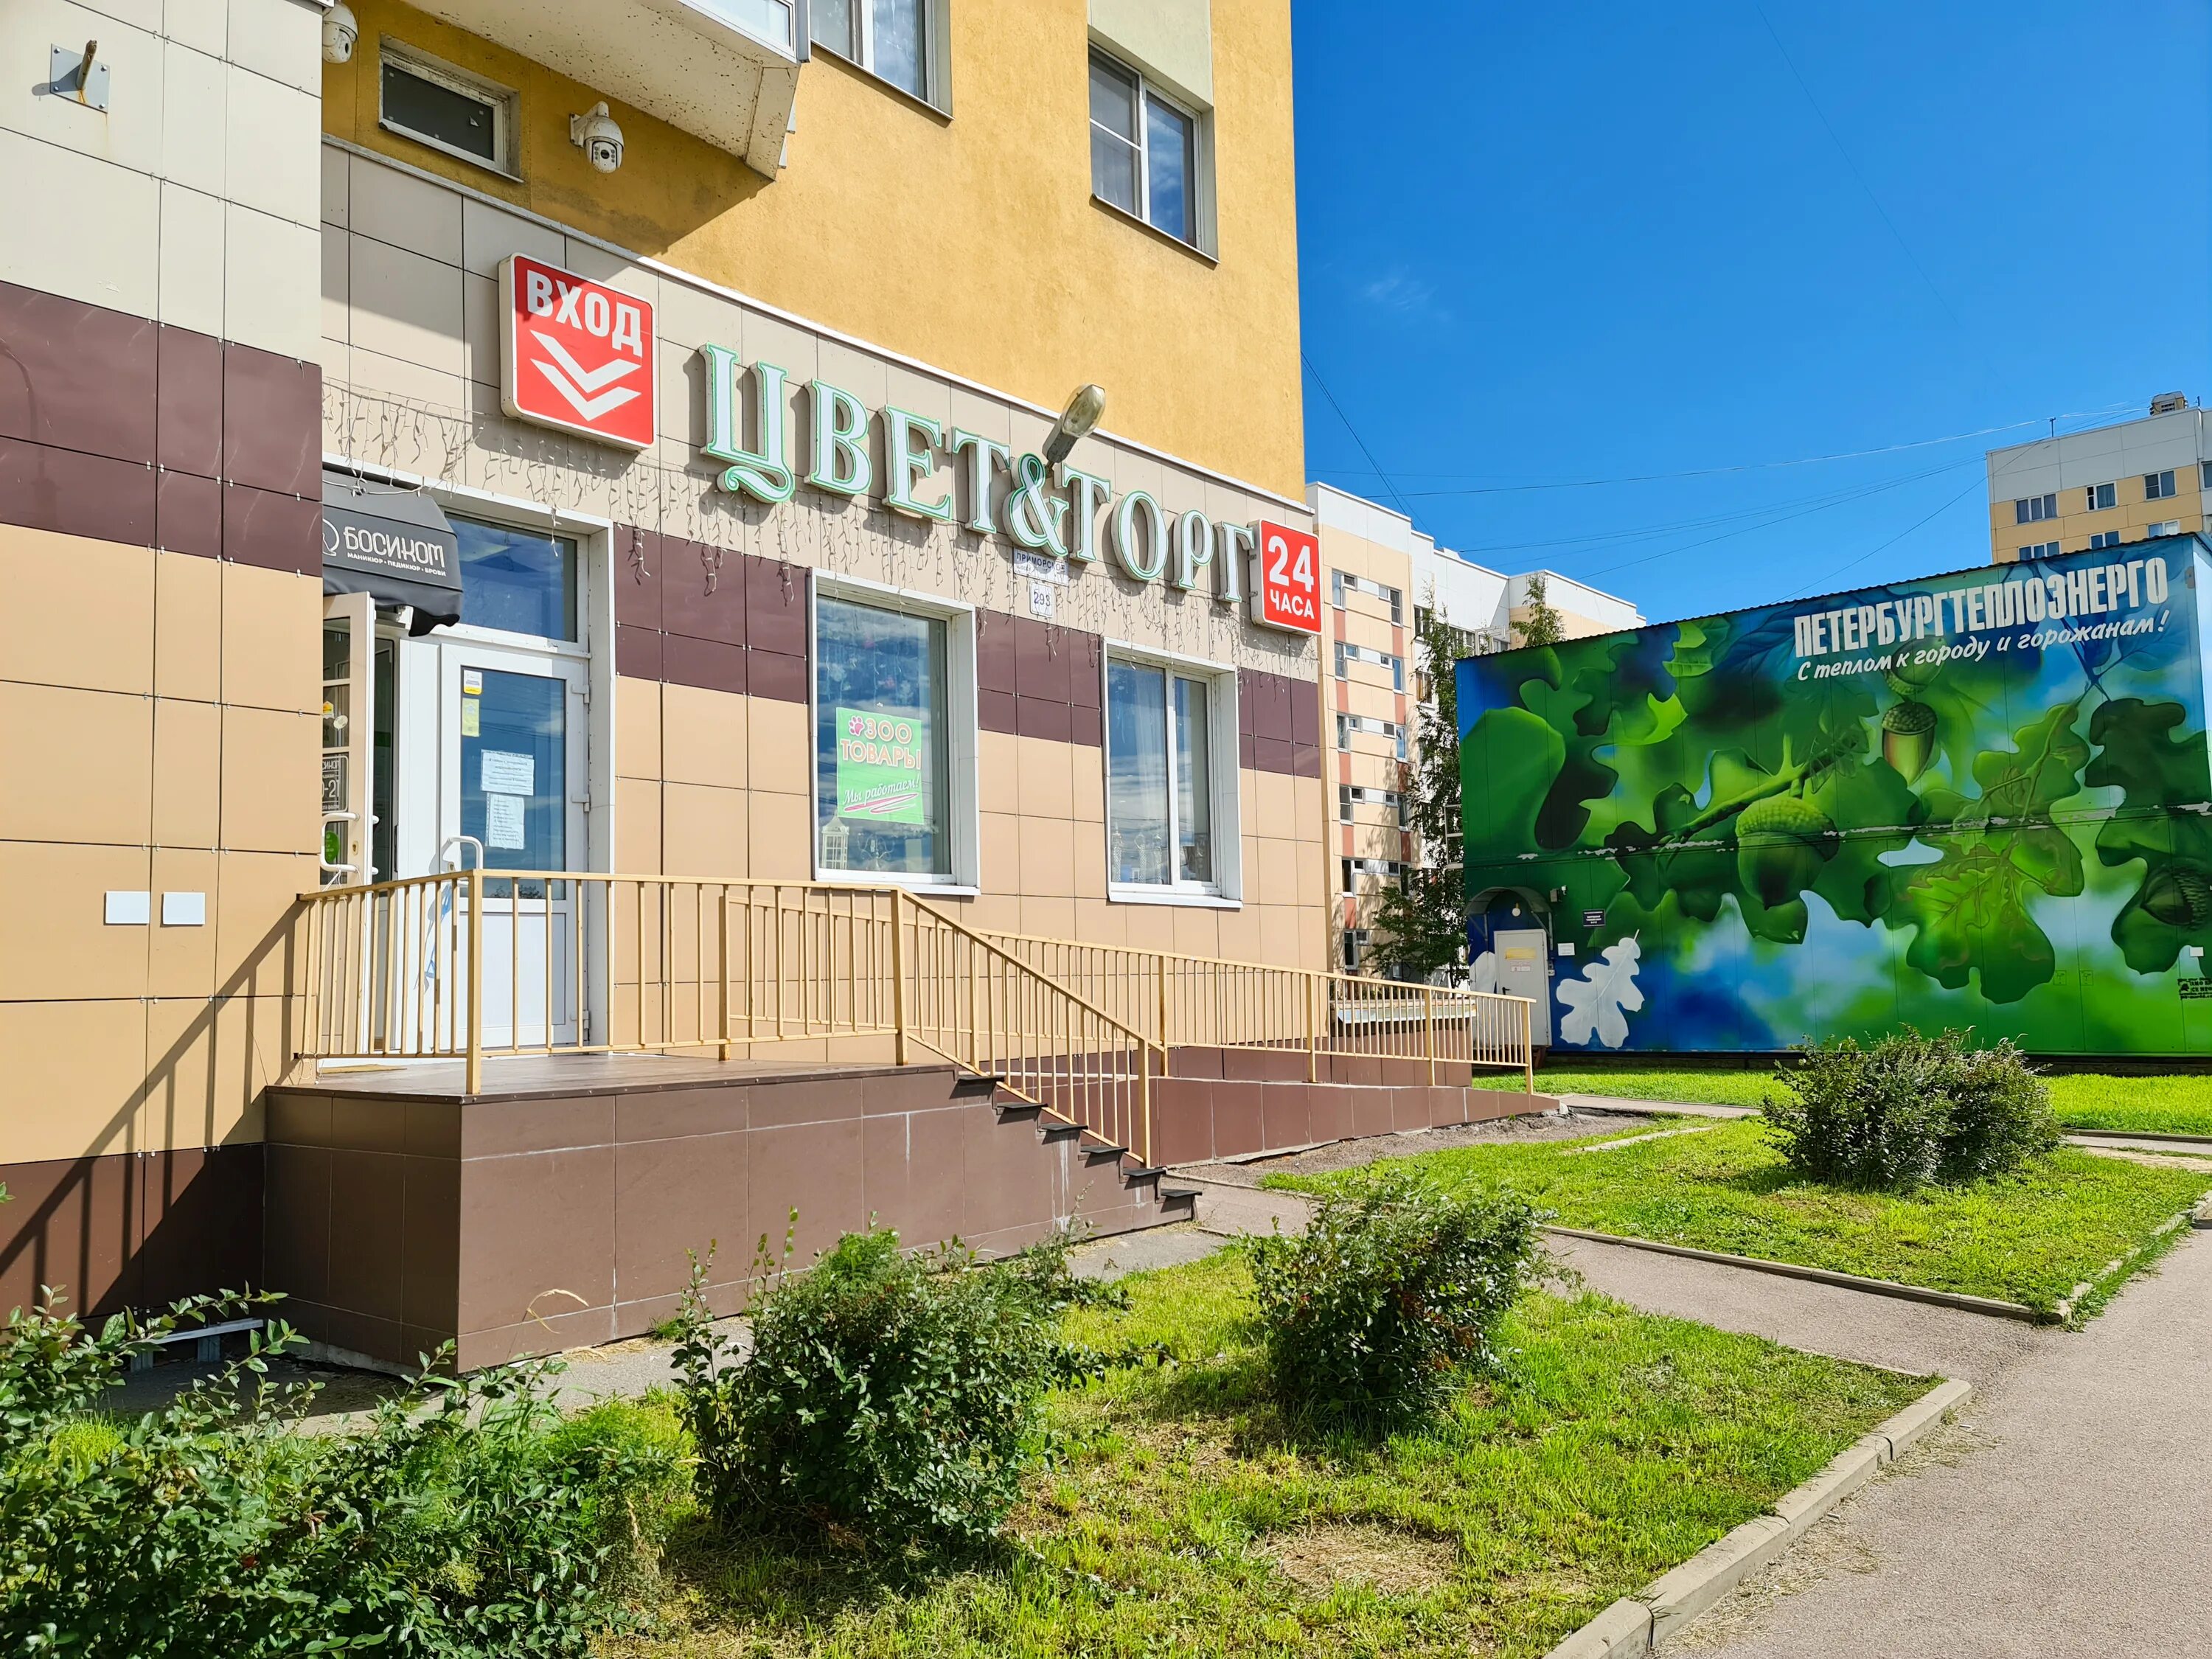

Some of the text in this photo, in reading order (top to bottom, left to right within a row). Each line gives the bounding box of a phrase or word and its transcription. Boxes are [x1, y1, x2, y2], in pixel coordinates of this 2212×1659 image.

[526, 269, 643, 358] ВХОД
[702, 341, 1255, 602] ЦВЕТ&ТОРГ
[343, 526, 445, 568] БОСИКОМ
[347, 552, 447, 577] МАНИКЮР ПЕДИКЮР БРОВИ
[1267, 535, 1315, 593] 24
[1033, 591, 1051, 607] 293
[1269, 588, 1315, 620] ЧАСА
[1794, 557, 2168, 658] ПЕТЕРБУРГТЕПЛОЭНЕРГО
[1798, 609, 2171, 681] С теплом к городу и горожанам!
[864, 717, 913, 744] ЗОО
[840, 738, 922, 770] ТОВАРЫ
[842, 773, 920, 806] Мы работаем!
